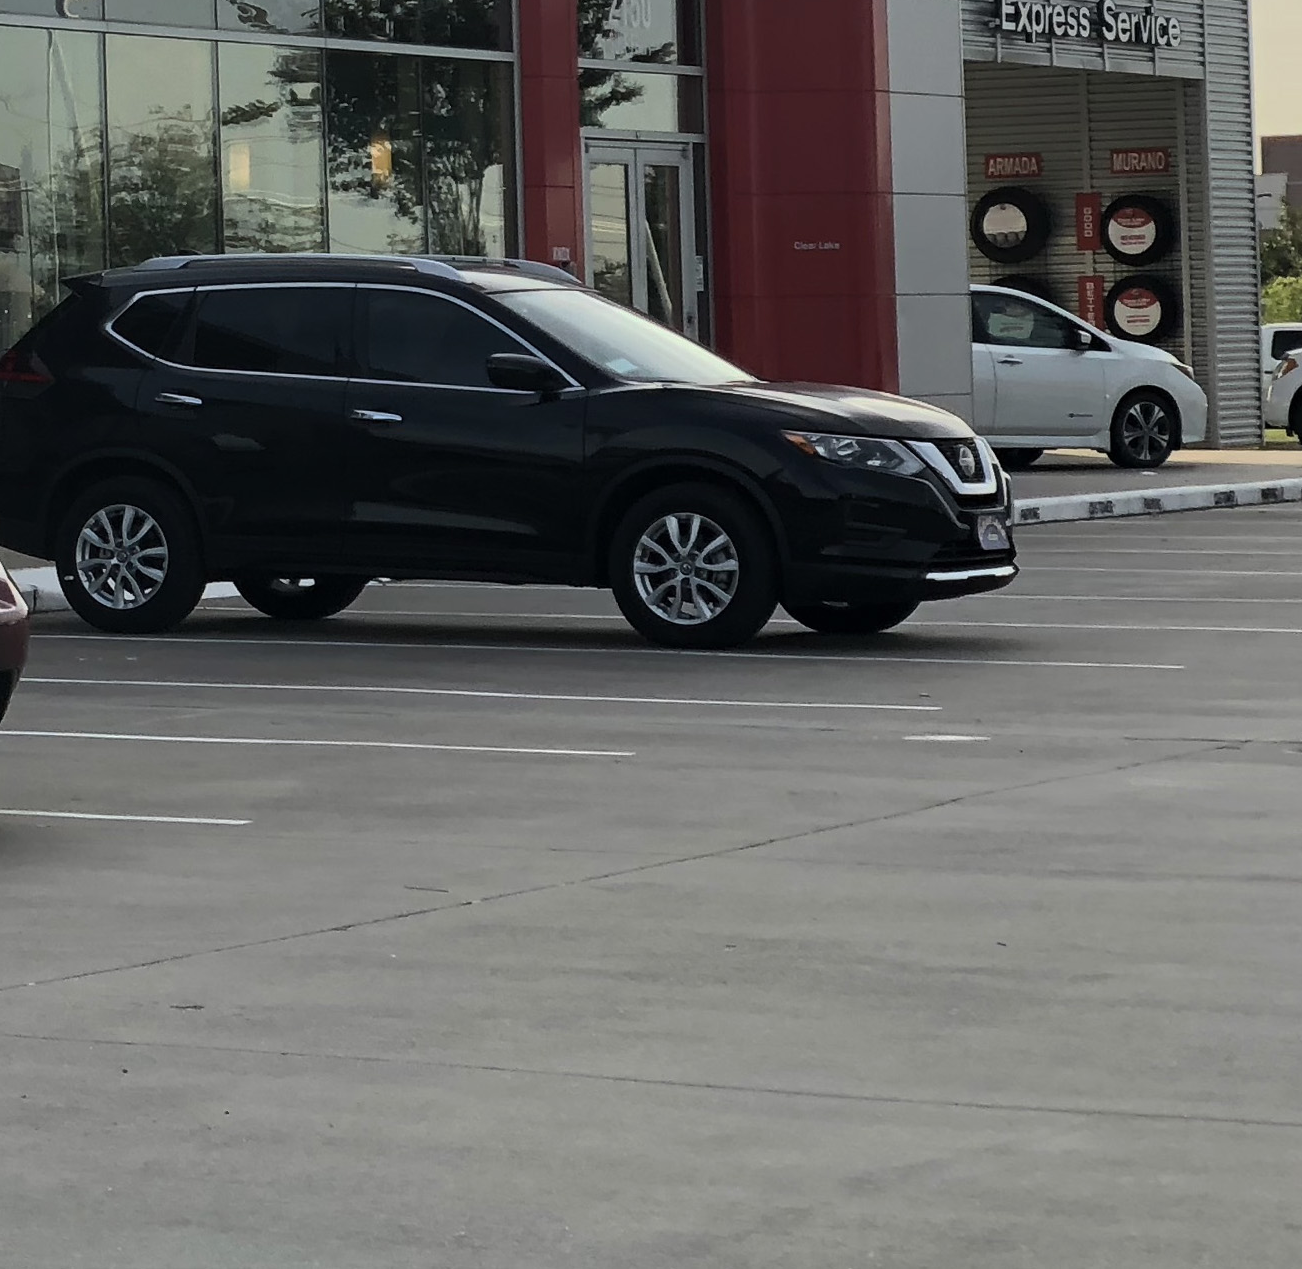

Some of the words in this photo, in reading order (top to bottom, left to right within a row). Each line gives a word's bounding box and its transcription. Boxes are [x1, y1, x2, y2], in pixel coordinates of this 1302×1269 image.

[988, 156, 1039, 176] ARMADA
[1112, 151, 1166, 171] MURANO
[794, 241, 817, 251] Clear
[818, 241, 841, 250] Lake
